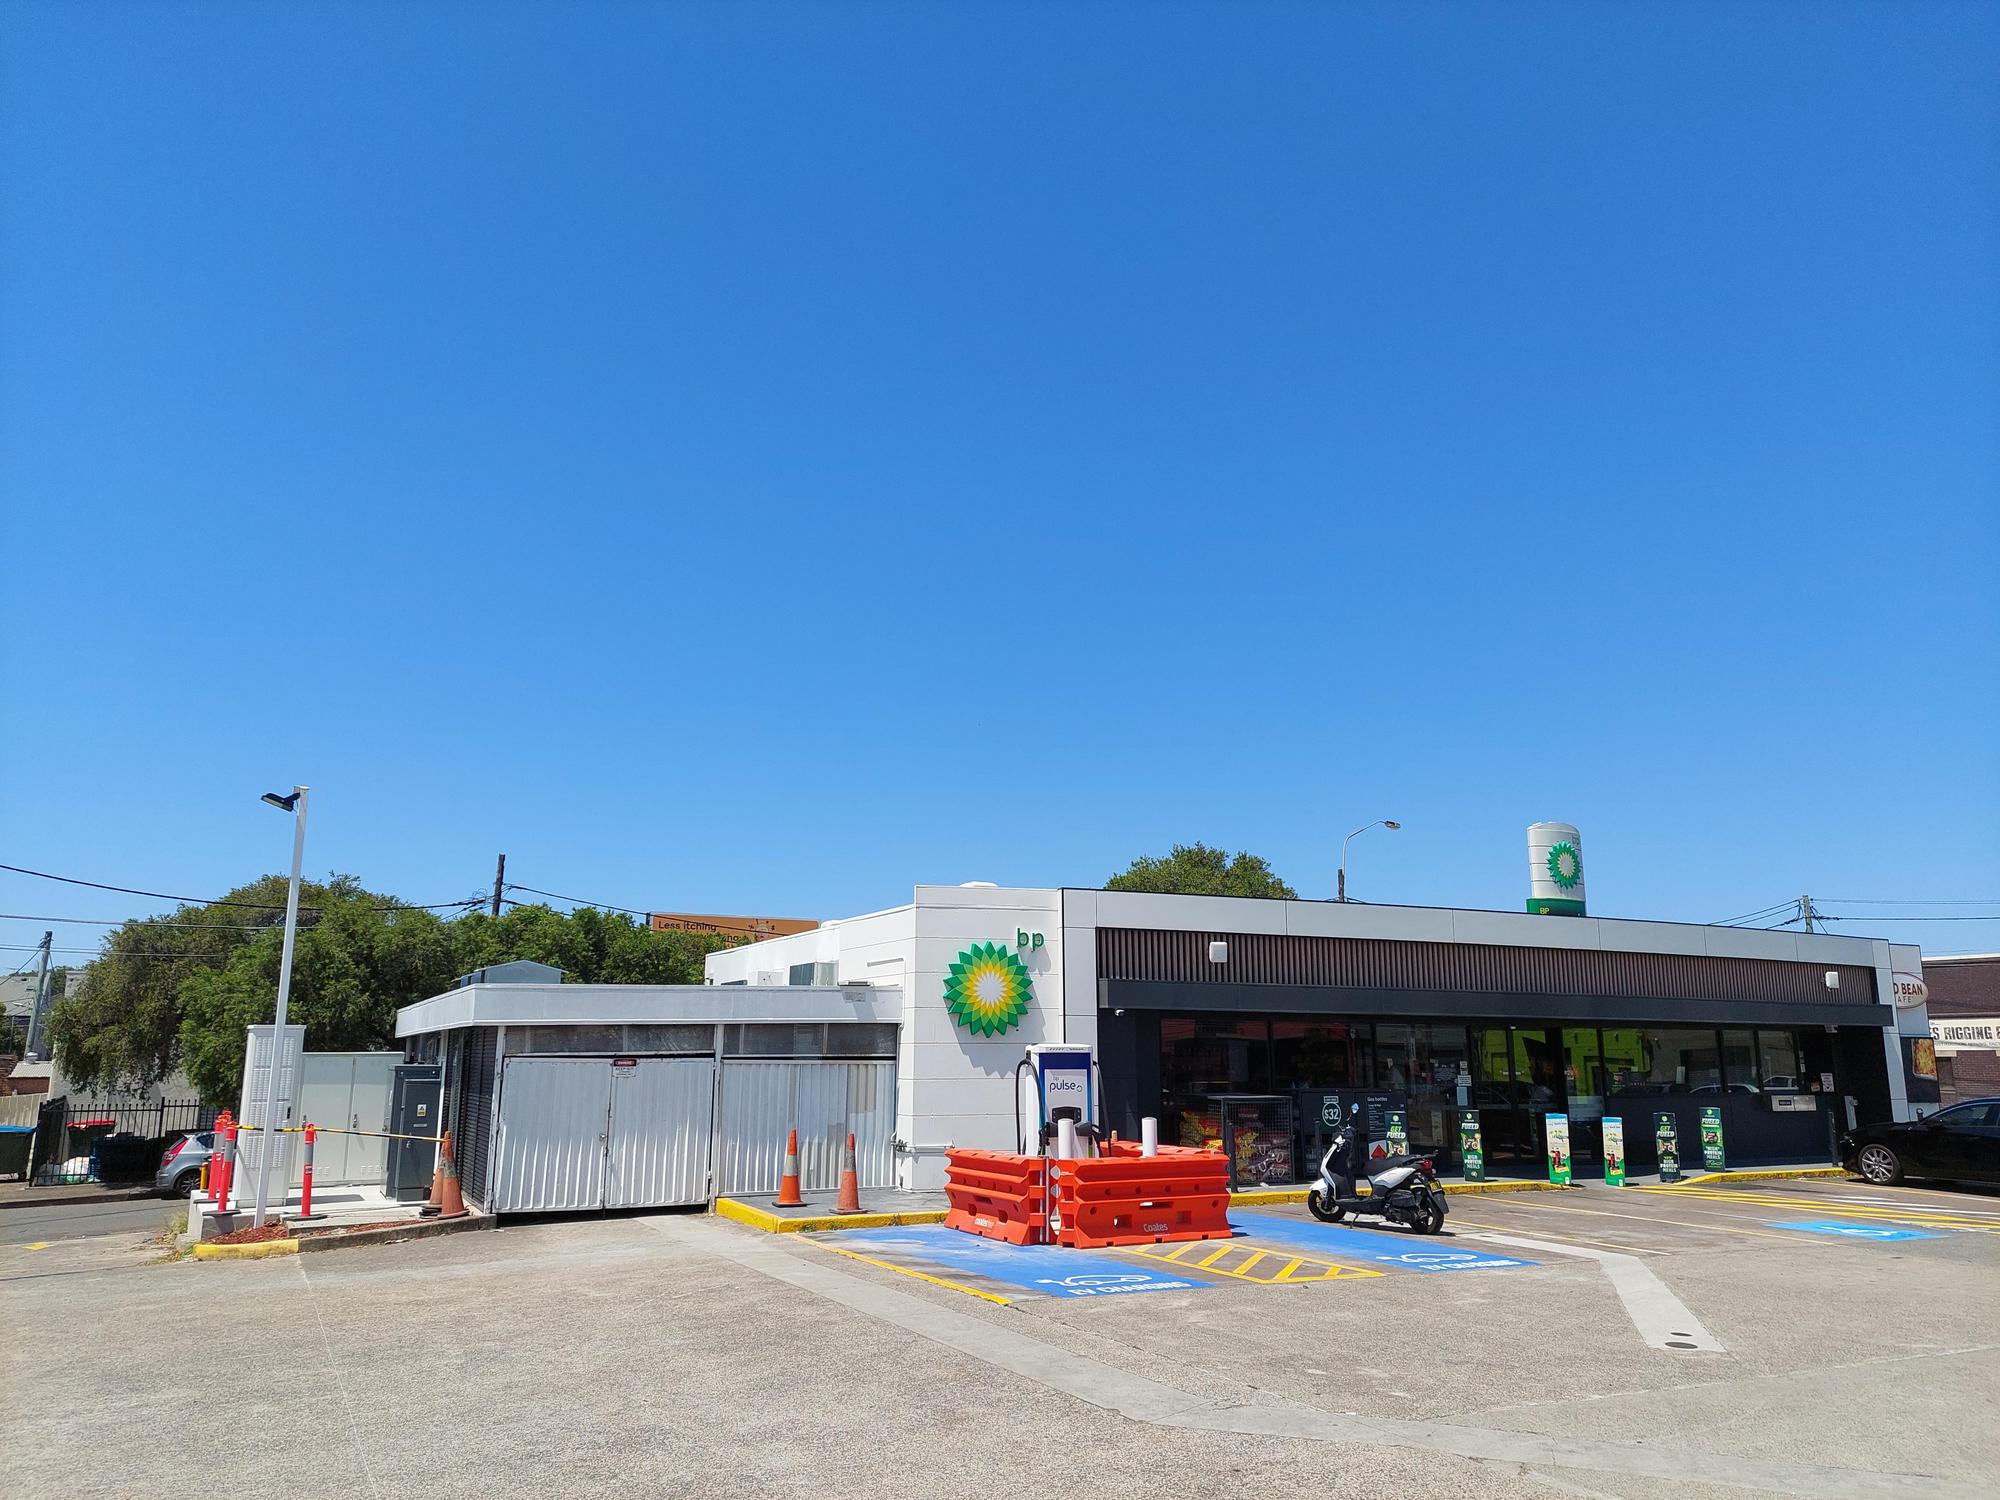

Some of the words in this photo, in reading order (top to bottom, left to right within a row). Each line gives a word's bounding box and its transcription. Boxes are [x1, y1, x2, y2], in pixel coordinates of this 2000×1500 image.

[658, 921, 680, 929] Less
[1016, 927, 1045, 952] bp
[1901, 982, 1923, 995] BEAN
[1943, 1026, 1993, 1040] RIGGING
[1049, 1079, 1076, 1093] pulse
[1324, 1108, 1339, 1120] $32
[1143, 1223, 1169, 1233] Coates
[1067, 1288, 1096, 1296] EV
